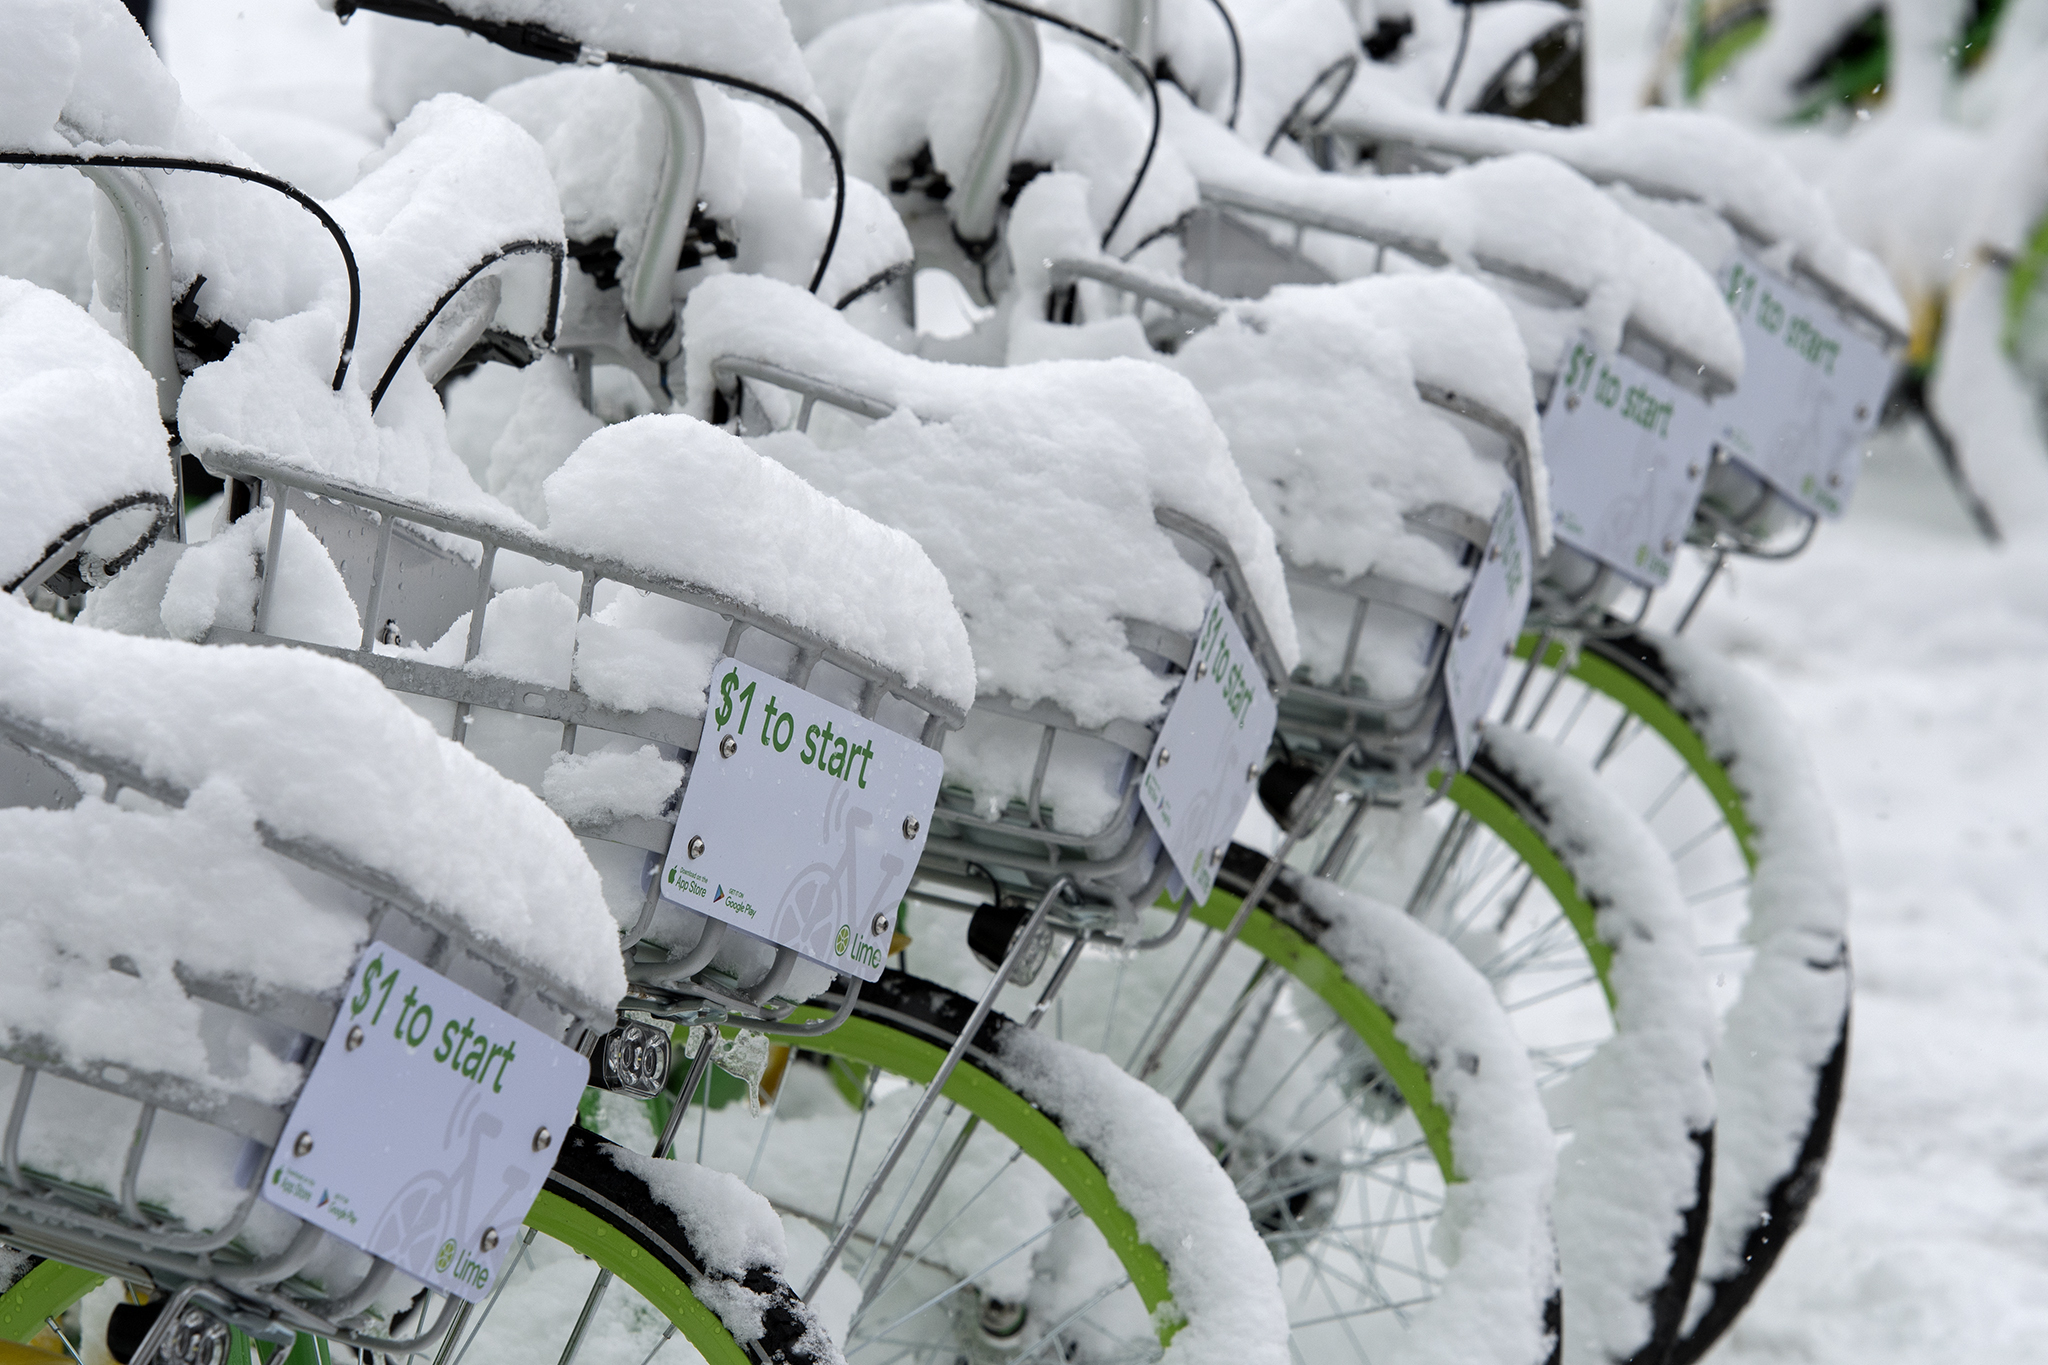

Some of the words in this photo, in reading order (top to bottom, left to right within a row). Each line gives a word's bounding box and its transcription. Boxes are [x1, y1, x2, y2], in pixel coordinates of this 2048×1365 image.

[1757, 290, 1784, 335] to
[1785, 316, 1840, 376] start
[1565, 342, 1596, 395] $1
[1594, 364, 1621, 409] to
[1621, 384, 1674, 439] start
[1200, 602, 1224, 662] $1
[1212, 632, 1230, 684] to
[1222, 662, 1256, 730] start
[715, 667, 757, 735] $1
[761, 695, 795, 753] to
[800, 720, 874, 790] start
[675, 875, 689, 892] App
[688, 880, 707, 898] Store
[725, 895, 745, 914] Google
[744, 903, 757, 919] Play
[351, 953, 400, 1026] $1
[394, 985, 434, 1049] to
[434, 1017, 515, 1094] start
